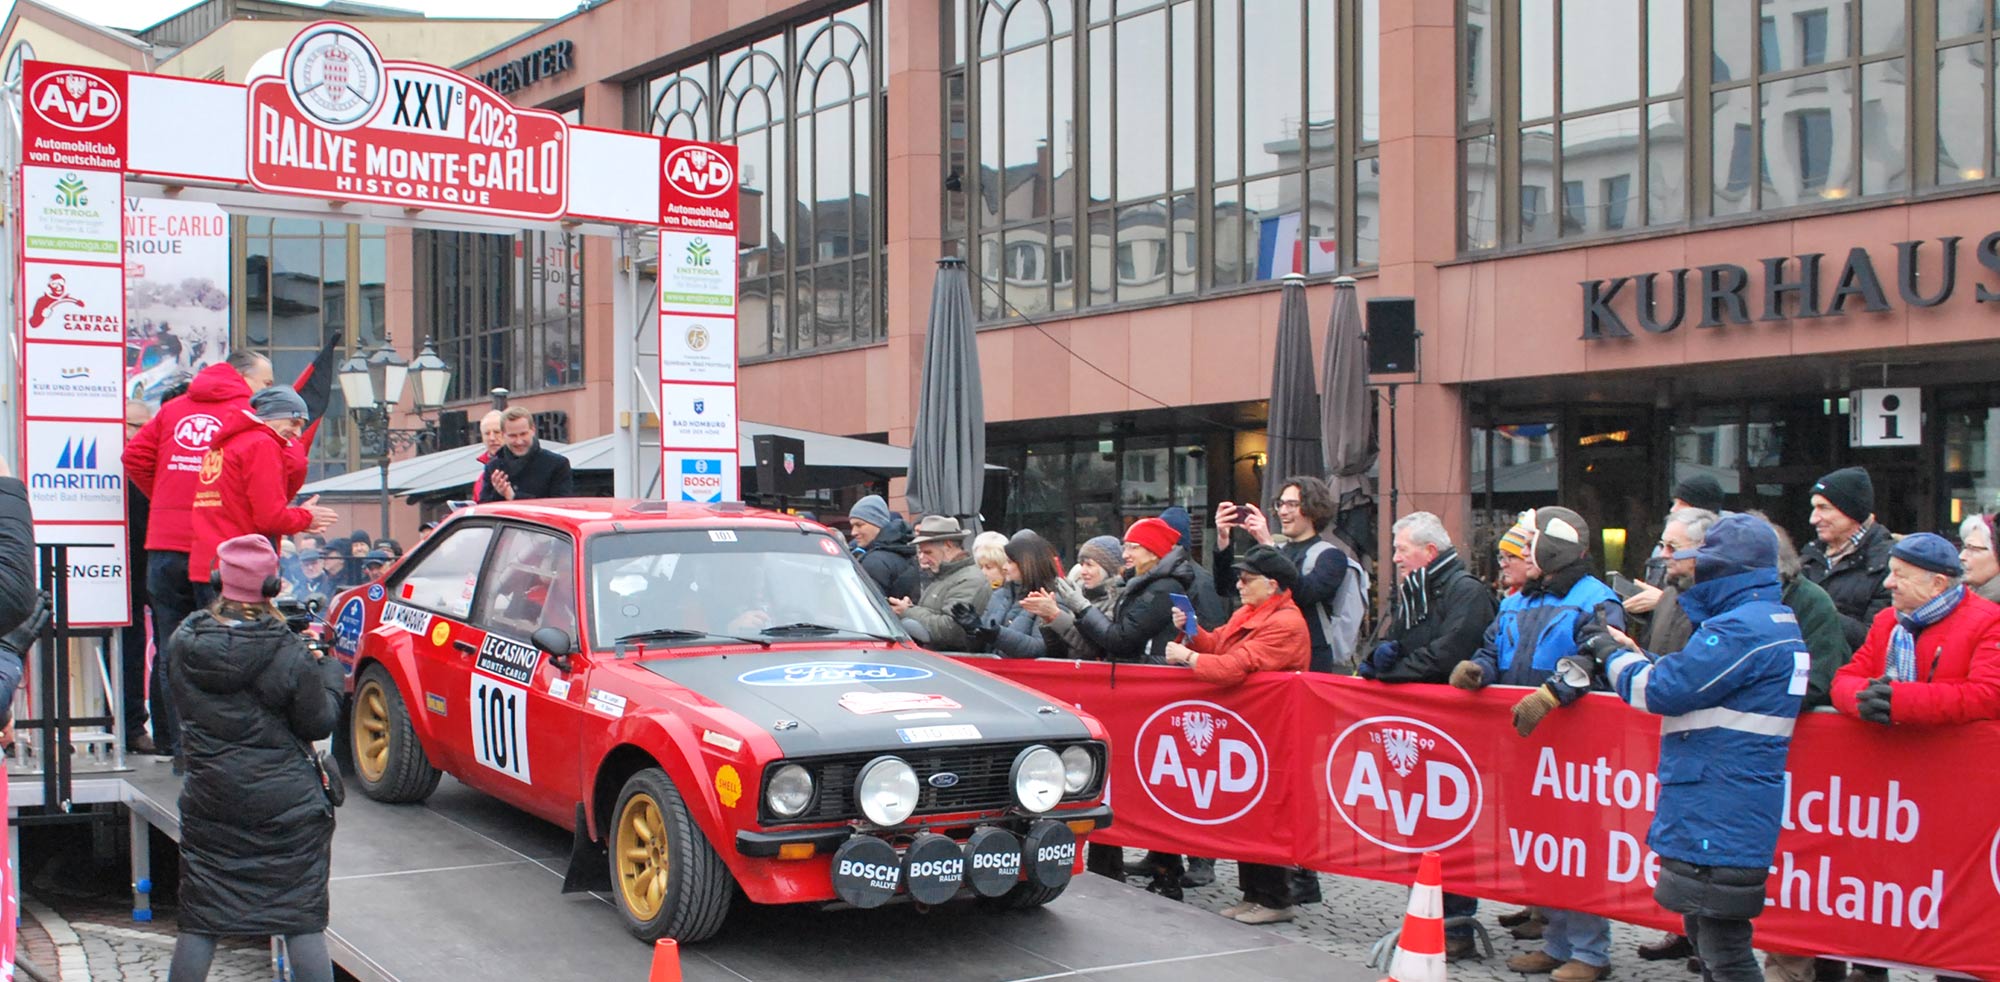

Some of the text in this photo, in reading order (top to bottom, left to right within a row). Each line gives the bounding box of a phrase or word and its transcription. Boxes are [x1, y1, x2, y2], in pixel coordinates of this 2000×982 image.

[478, 39, 574, 95] CENTER
[468, 94, 517, 149] 2023
[35, 137, 115, 155] Automobilclub
[259, 102, 558, 195] RALLYE MONTE-CARLO
[29, 152, 120, 168] von Deutschland
[337, 175, 490, 205] HISTORIQUE
[43, 207, 99, 218] ENSTROGA
[667, 203, 730, 219] Automobilclub
[663, 216, 734, 230] von Deutschland
[31, 237, 115, 252] www.enstroga.de
[676, 267, 719, 276] ENSTROGA
[64, 313, 119, 324] CENTRAL
[64, 323, 119, 333] GARAGE
[32, 473, 120, 489] MARITIM
[684, 477, 720, 487] BOSCH
[33, 492, 120, 504] Hotel Bad Homburg
[715, 532, 731, 540] 101
[784, 663, 896, 682] Ford
[479, 684, 519, 773] 101
[1171, 716, 1228, 729] 18 99
[1369, 731, 1435, 751] 18 99
[719, 779, 738, 794] SHELL
[973, 852, 1021, 869] BOSCH
[1038, 843, 1076, 862] BOSCH
[1509, 827, 1586, 878] von
[910, 858, 963, 877] BOSCH
[1058, 857, 1075, 866] RALLYE
[839, 860, 899, 882] BOSCH
[939, 874, 962, 882] RALLYE
[999, 867, 1019, 875] RALLYE
[870, 880, 896, 890] RALLYE
